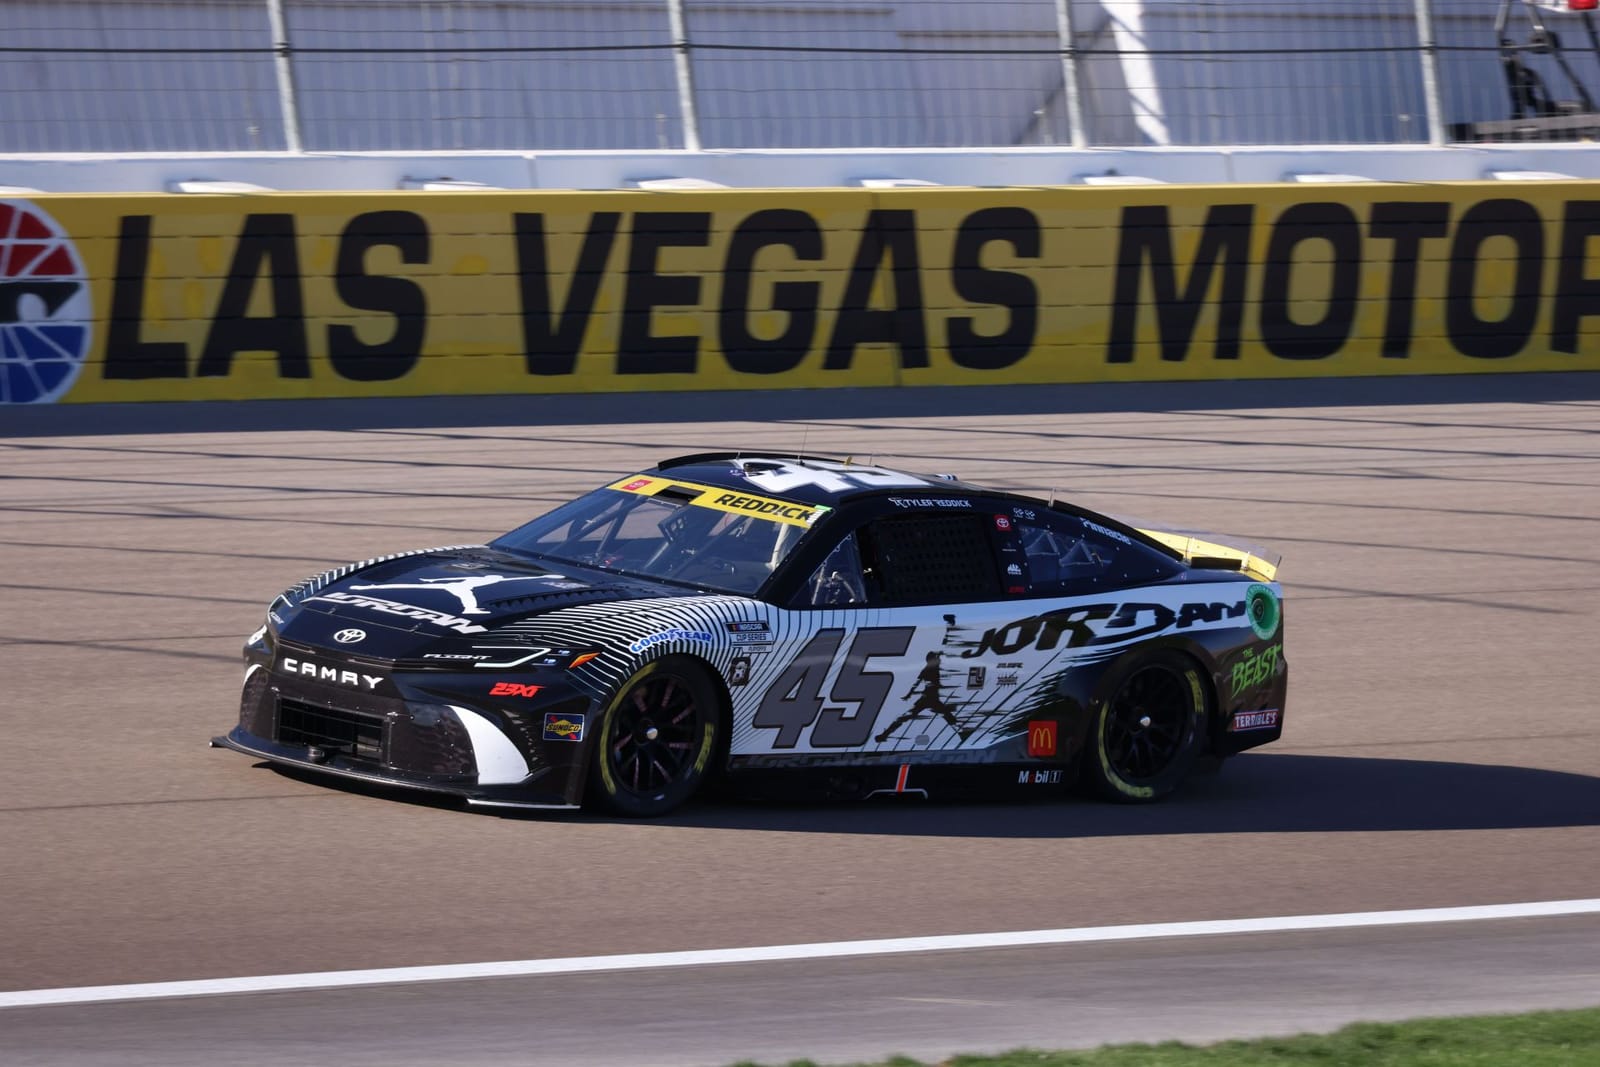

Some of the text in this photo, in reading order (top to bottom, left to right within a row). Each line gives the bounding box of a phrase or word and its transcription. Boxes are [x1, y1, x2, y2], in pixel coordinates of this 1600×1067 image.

[103, 210, 431, 381] LAS
[512, 206, 1042, 375] VEGAS
[714, 492, 816, 522] REDDICK
[934, 499, 972, 508] REDDICK
[630, 629, 712, 652] GOODYEAR
[962, 600, 1249, 659] JORDAN
[283, 658, 384, 689] CAMRY
[1231, 643, 1282, 698] BEAST
[753, 626, 916, 750] 45
[547, 723, 580, 731] SUNOCO
[1234, 713, 1278, 729] TERRIBLE'S
[1018, 769, 1049, 784] Mobil
